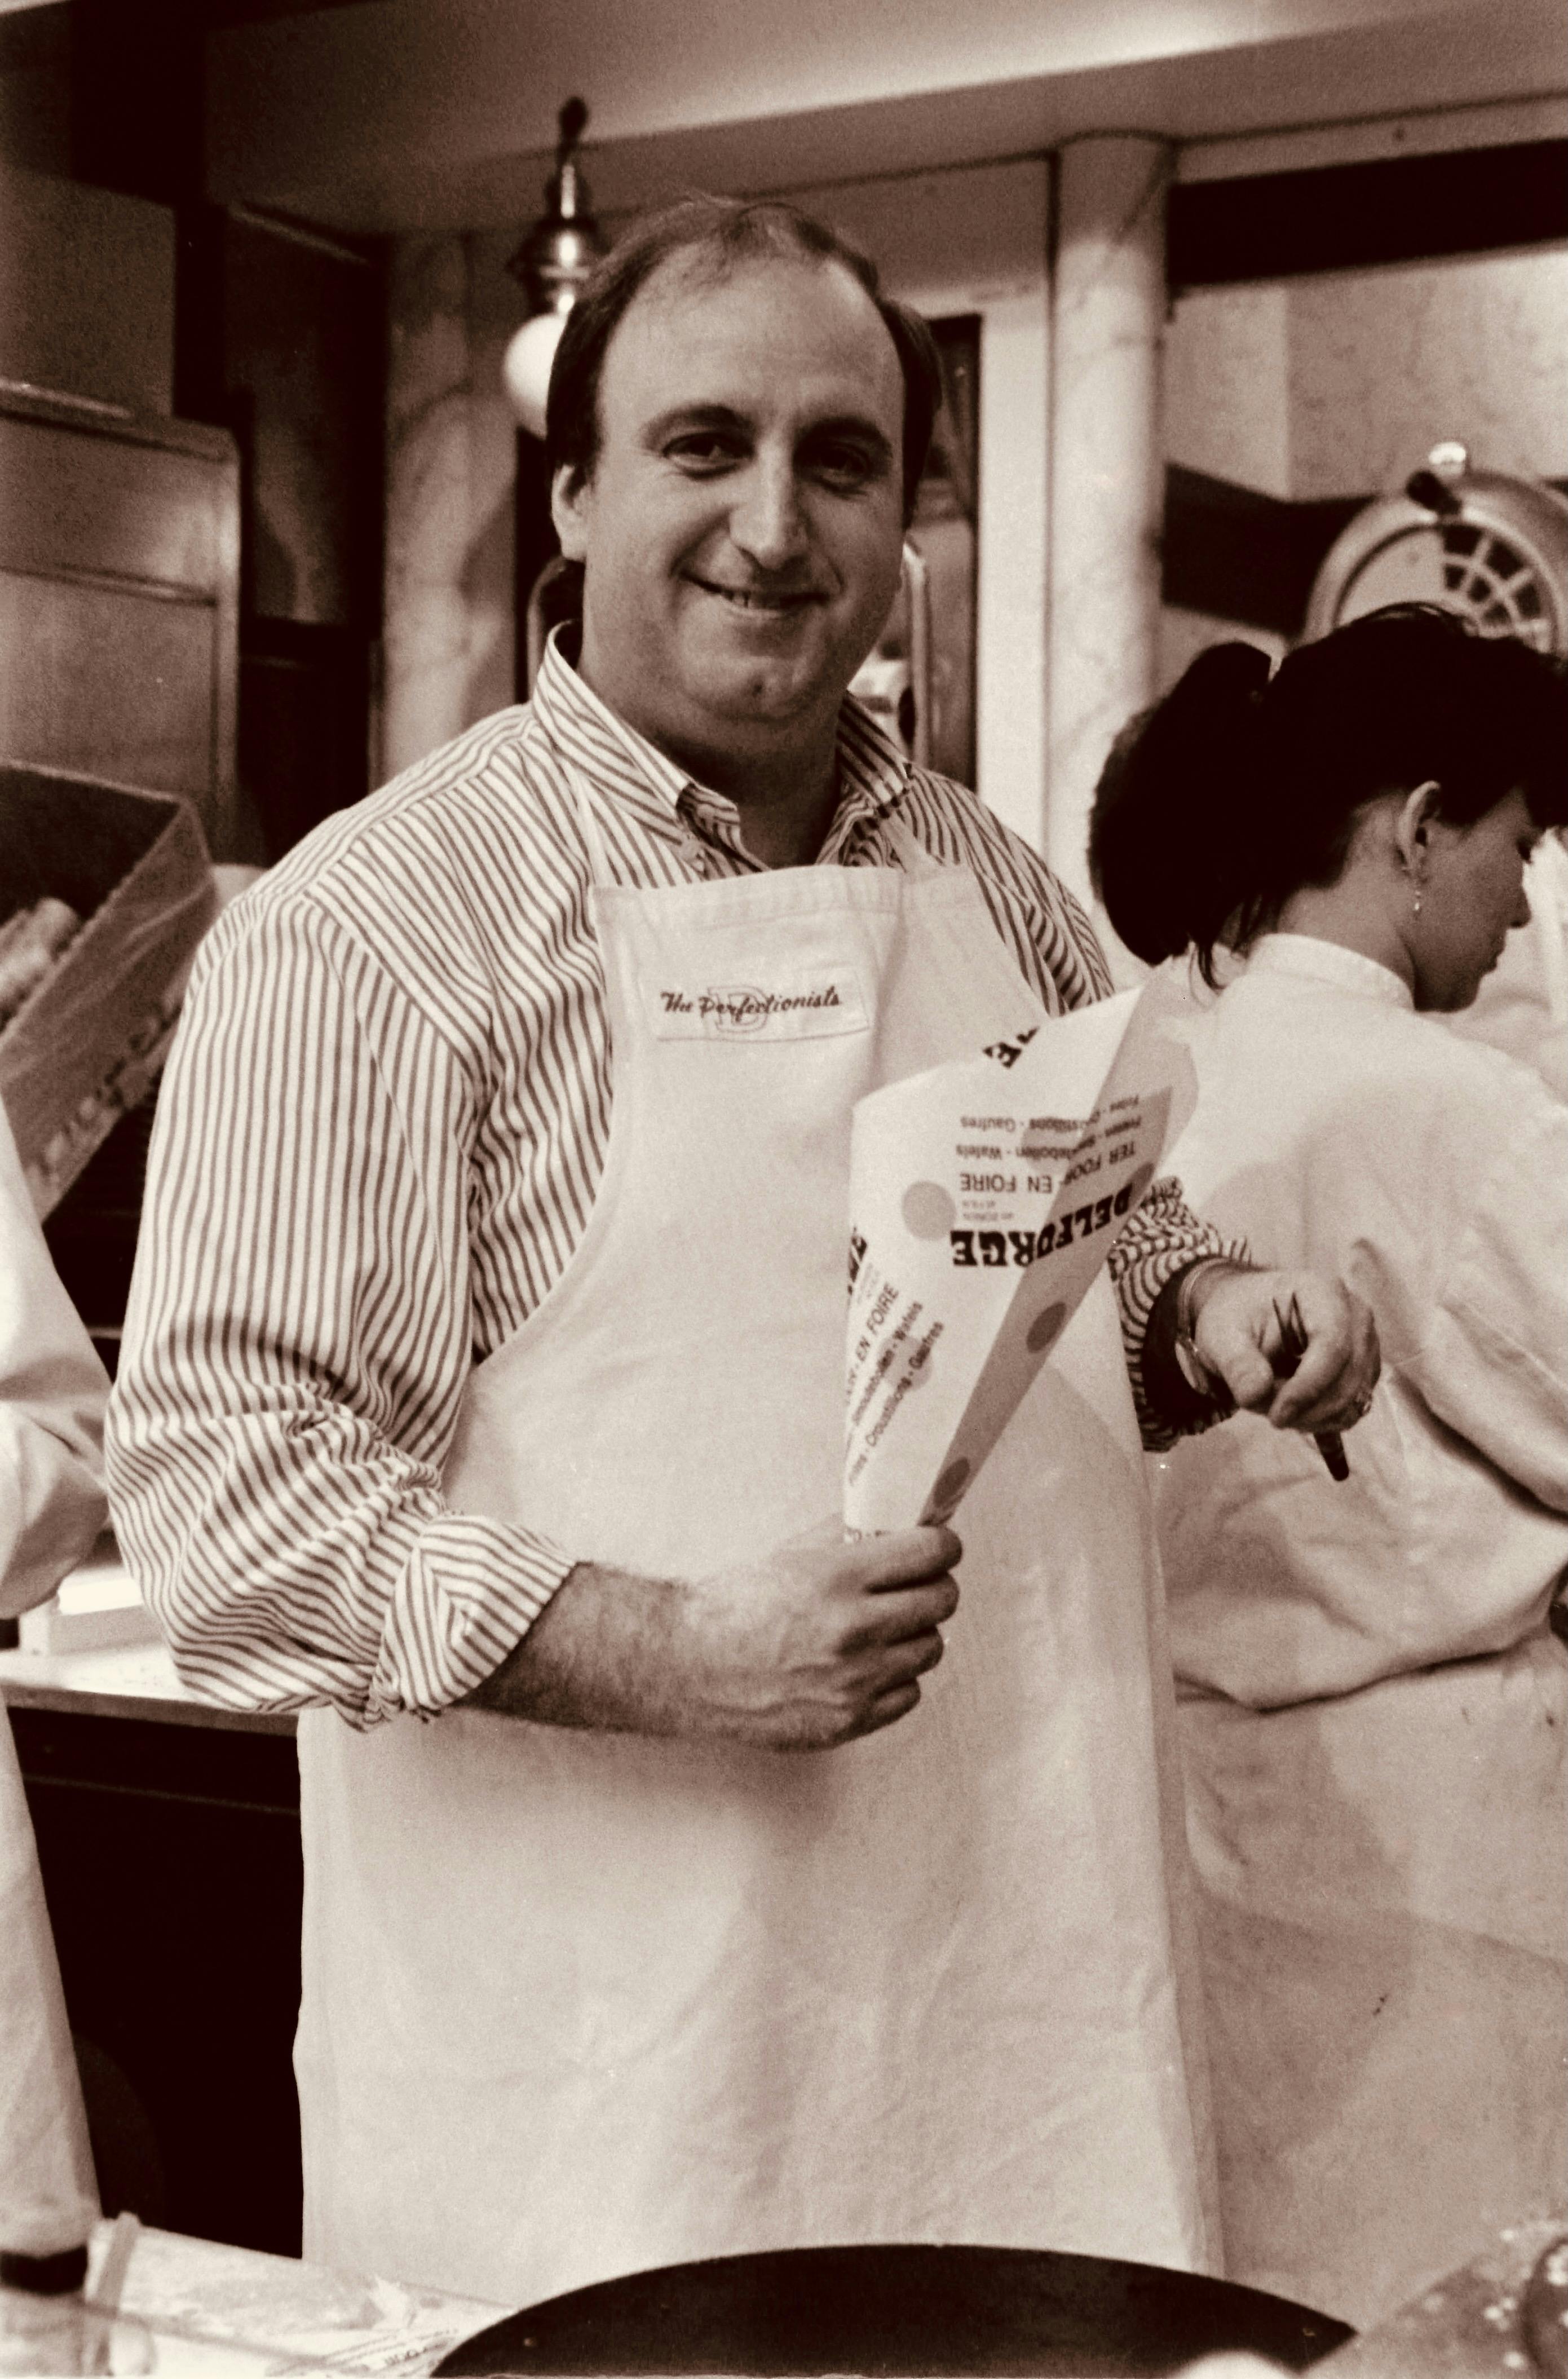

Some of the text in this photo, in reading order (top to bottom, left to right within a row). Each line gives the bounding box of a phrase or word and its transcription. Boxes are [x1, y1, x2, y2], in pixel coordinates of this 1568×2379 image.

[960, 1173, 1016, 1193] FOIRE
[1028, 1175, 1053, 1194] EN
[950, 1182, 1133, 1267] DELFORGE
[866, 1281, 899, 1335] FOIRE
